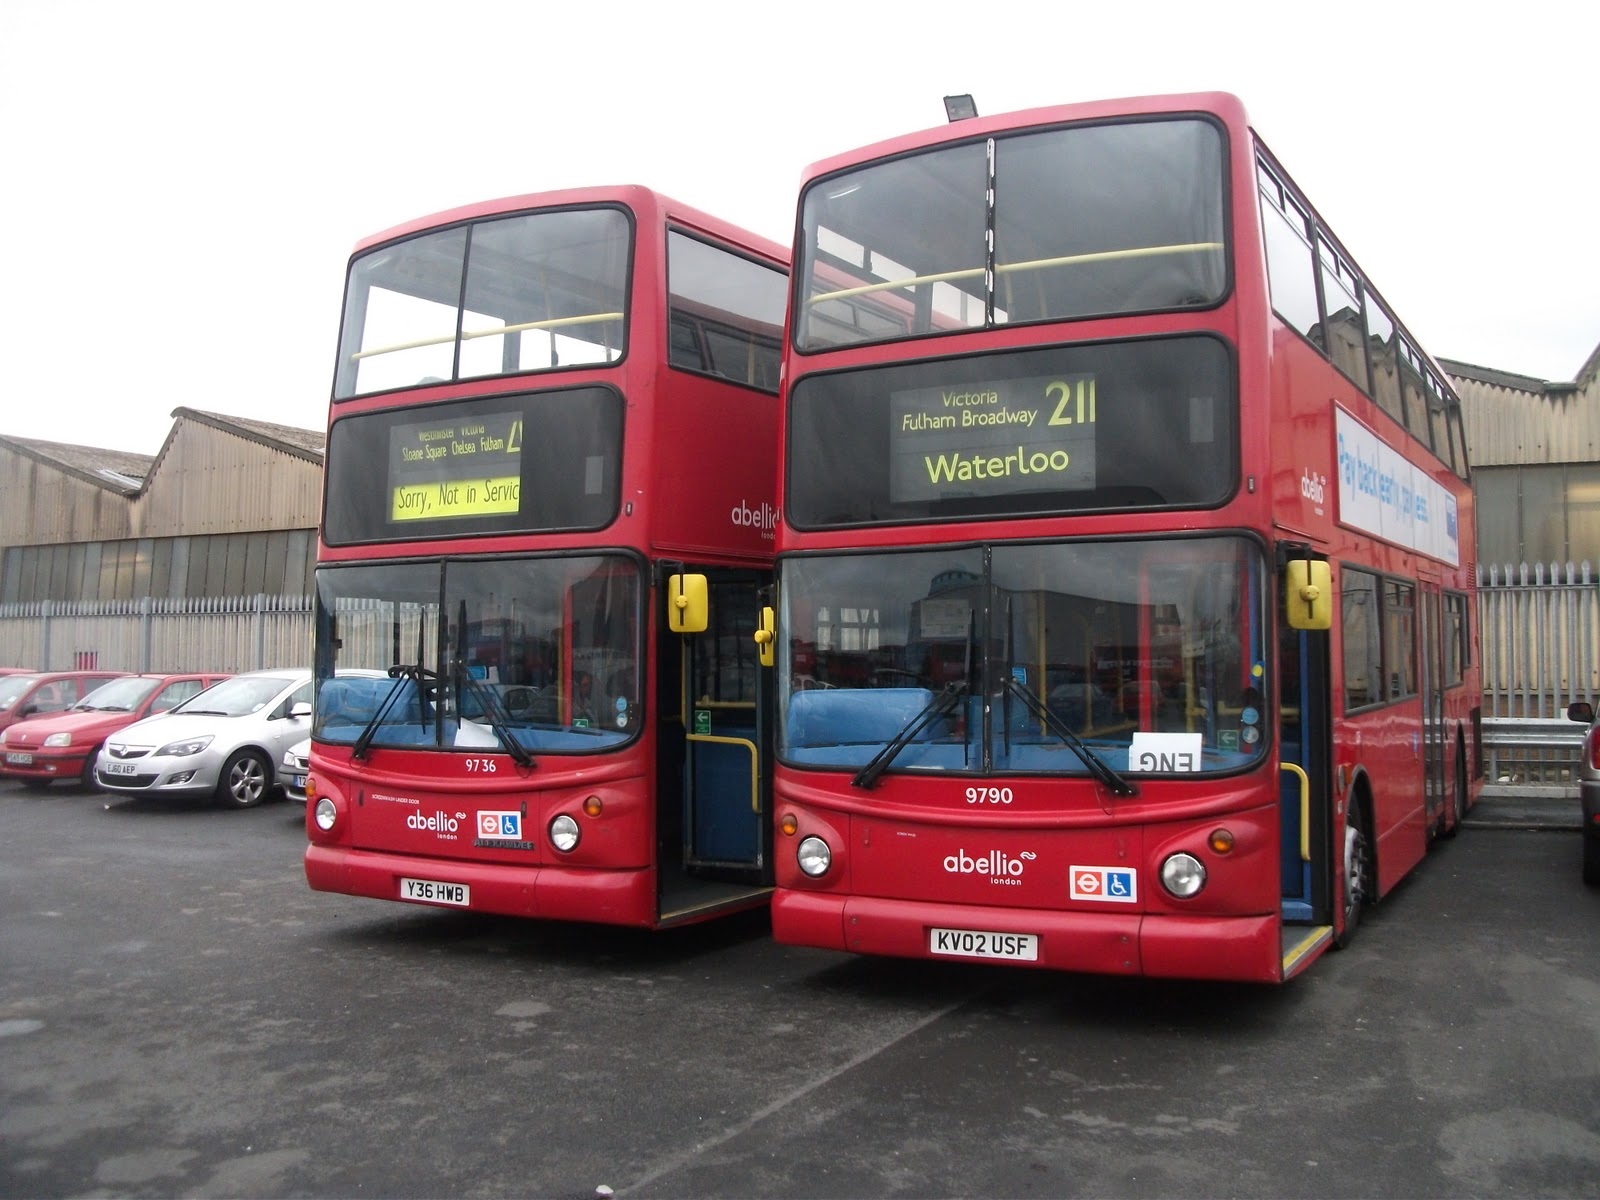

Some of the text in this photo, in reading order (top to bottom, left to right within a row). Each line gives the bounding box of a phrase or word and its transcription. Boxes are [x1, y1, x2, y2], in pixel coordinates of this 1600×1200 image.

[941, 389, 998, 407] Victoria
[1045, 379, 1096, 426] 211
[902, 406, 1038, 431] Fulham Broadway
[402, 436, 504, 462] Sloane Square Chelsea Fulham
[924, 446, 1069, 484] Waterloo
[398, 486, 431, 514] Sorry,
[439, 482, 459, 506] Not
[467, 485, 476, 503] in
[122, 764, 136, 774] AEP
[465, 759, 497, 773] 9736
[965, 787, 1014, 804] 9790
[407, 809, 458, 832] abellio
[943, 848, 1024, 876] abellio
[407, 881, 464, 902] Y36 HWB
[990, 877, 1022, 886] london
[937, 931, 1029, 956] KV02 USF
